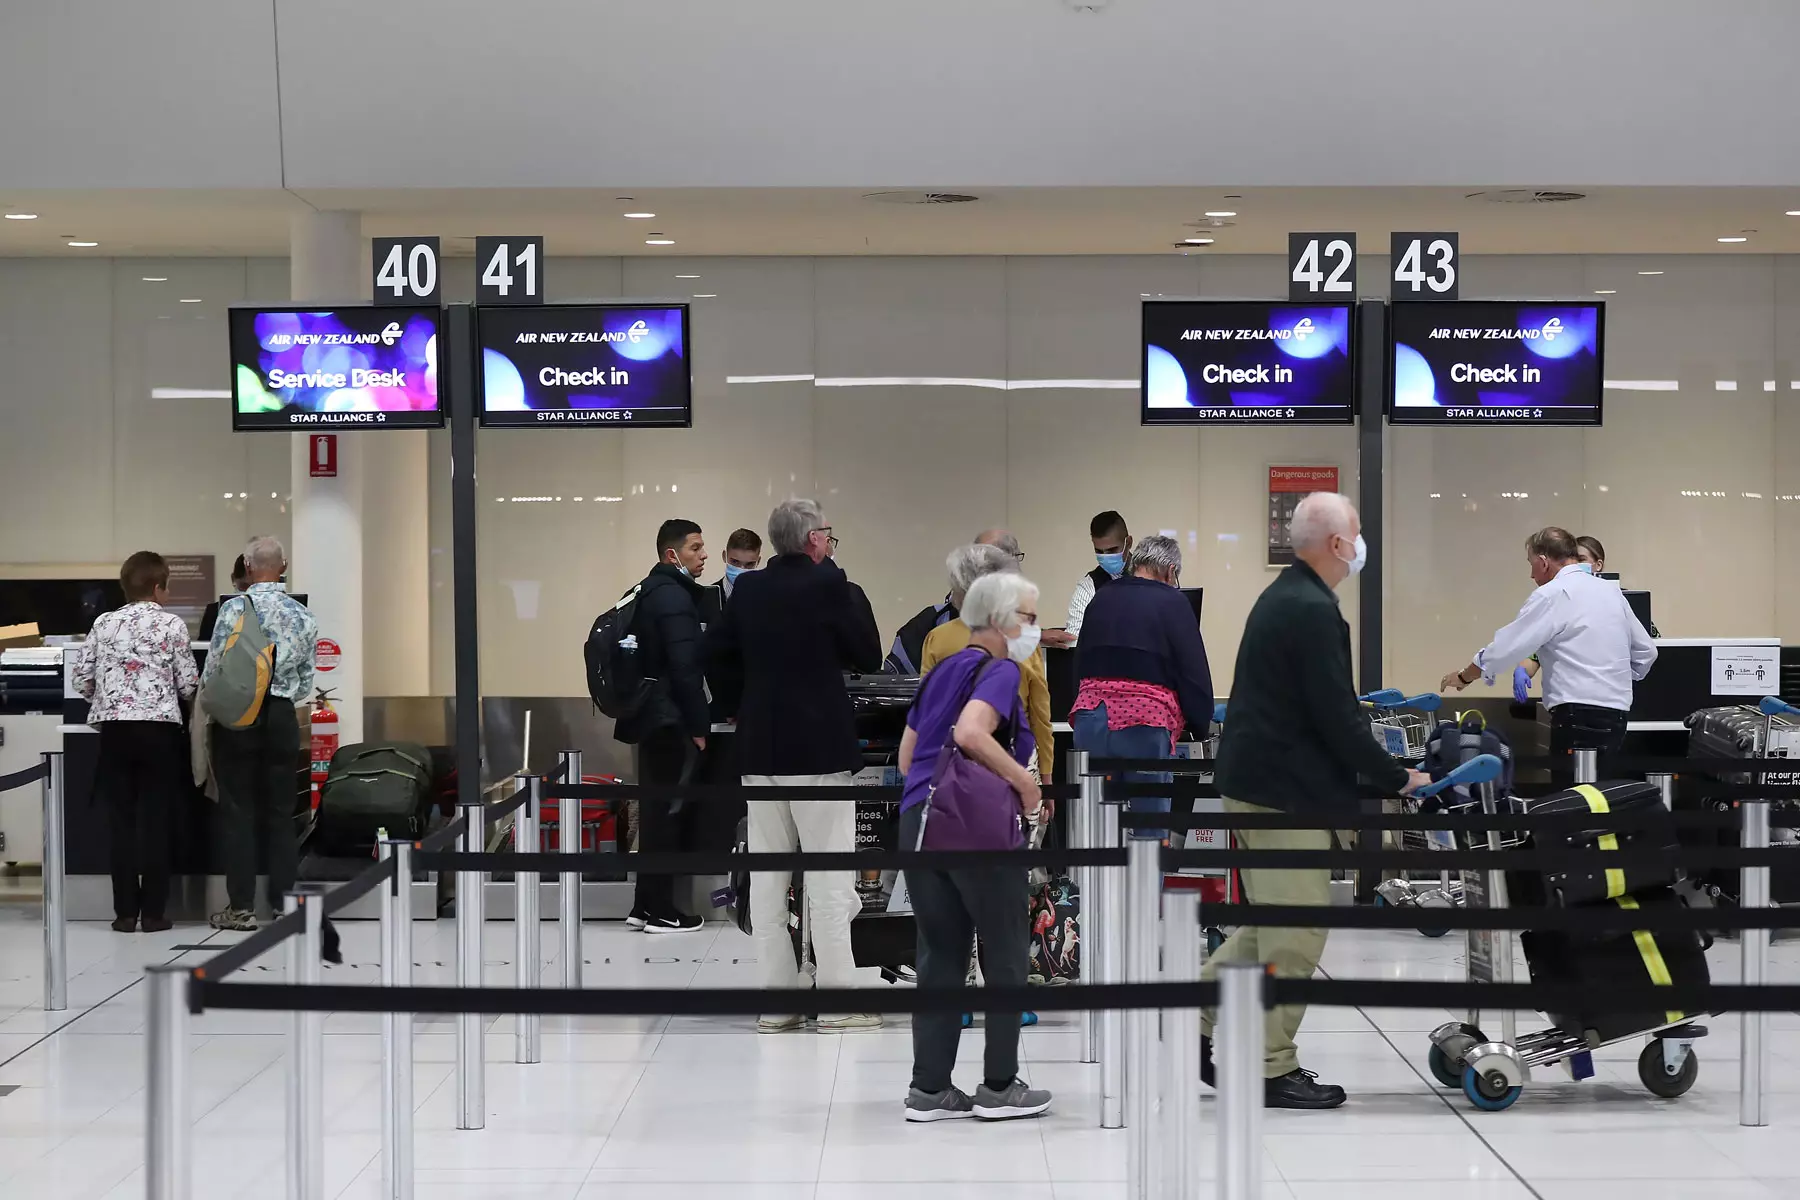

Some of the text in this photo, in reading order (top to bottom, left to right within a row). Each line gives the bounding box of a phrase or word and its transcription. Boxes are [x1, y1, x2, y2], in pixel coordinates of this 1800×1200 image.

[376, 244, 437, 297] 40
[482, 243, 536, 296] 41
[1292, 239, 1353, 292] 42
[1394, 239, 1455, 293] 43
[515, 332, 627, 344] AIR NEW ZEALAND
[1180, 329, 1292, 340] AIR NEW ZEALAND
[1428, 328, 1540, 339] AIR NEW ZEALAND
[269, 334, 380, 345] AIR NEW ZEALAND
[268, 368, 406, 389] Service Desk
[539, 366, 629, 386] Check in
[1203, 364, 1293, 384] Check in
[1450, 363, 1541, 383] Check in
[290, 413, 374, 423] STAR ALLIANCE
[537, 411, 620, 421] STAR ALLIANCE
[1199, 409, 1283, 418] STAR ALLIANCE
[1446, 408, 1530, 418] STAR ALLIANCE
[1271, 470, 1334, 480] Dangerous goods
[1767, 772, 1777, 780] At
[1778, 772, 1791, 780] our
